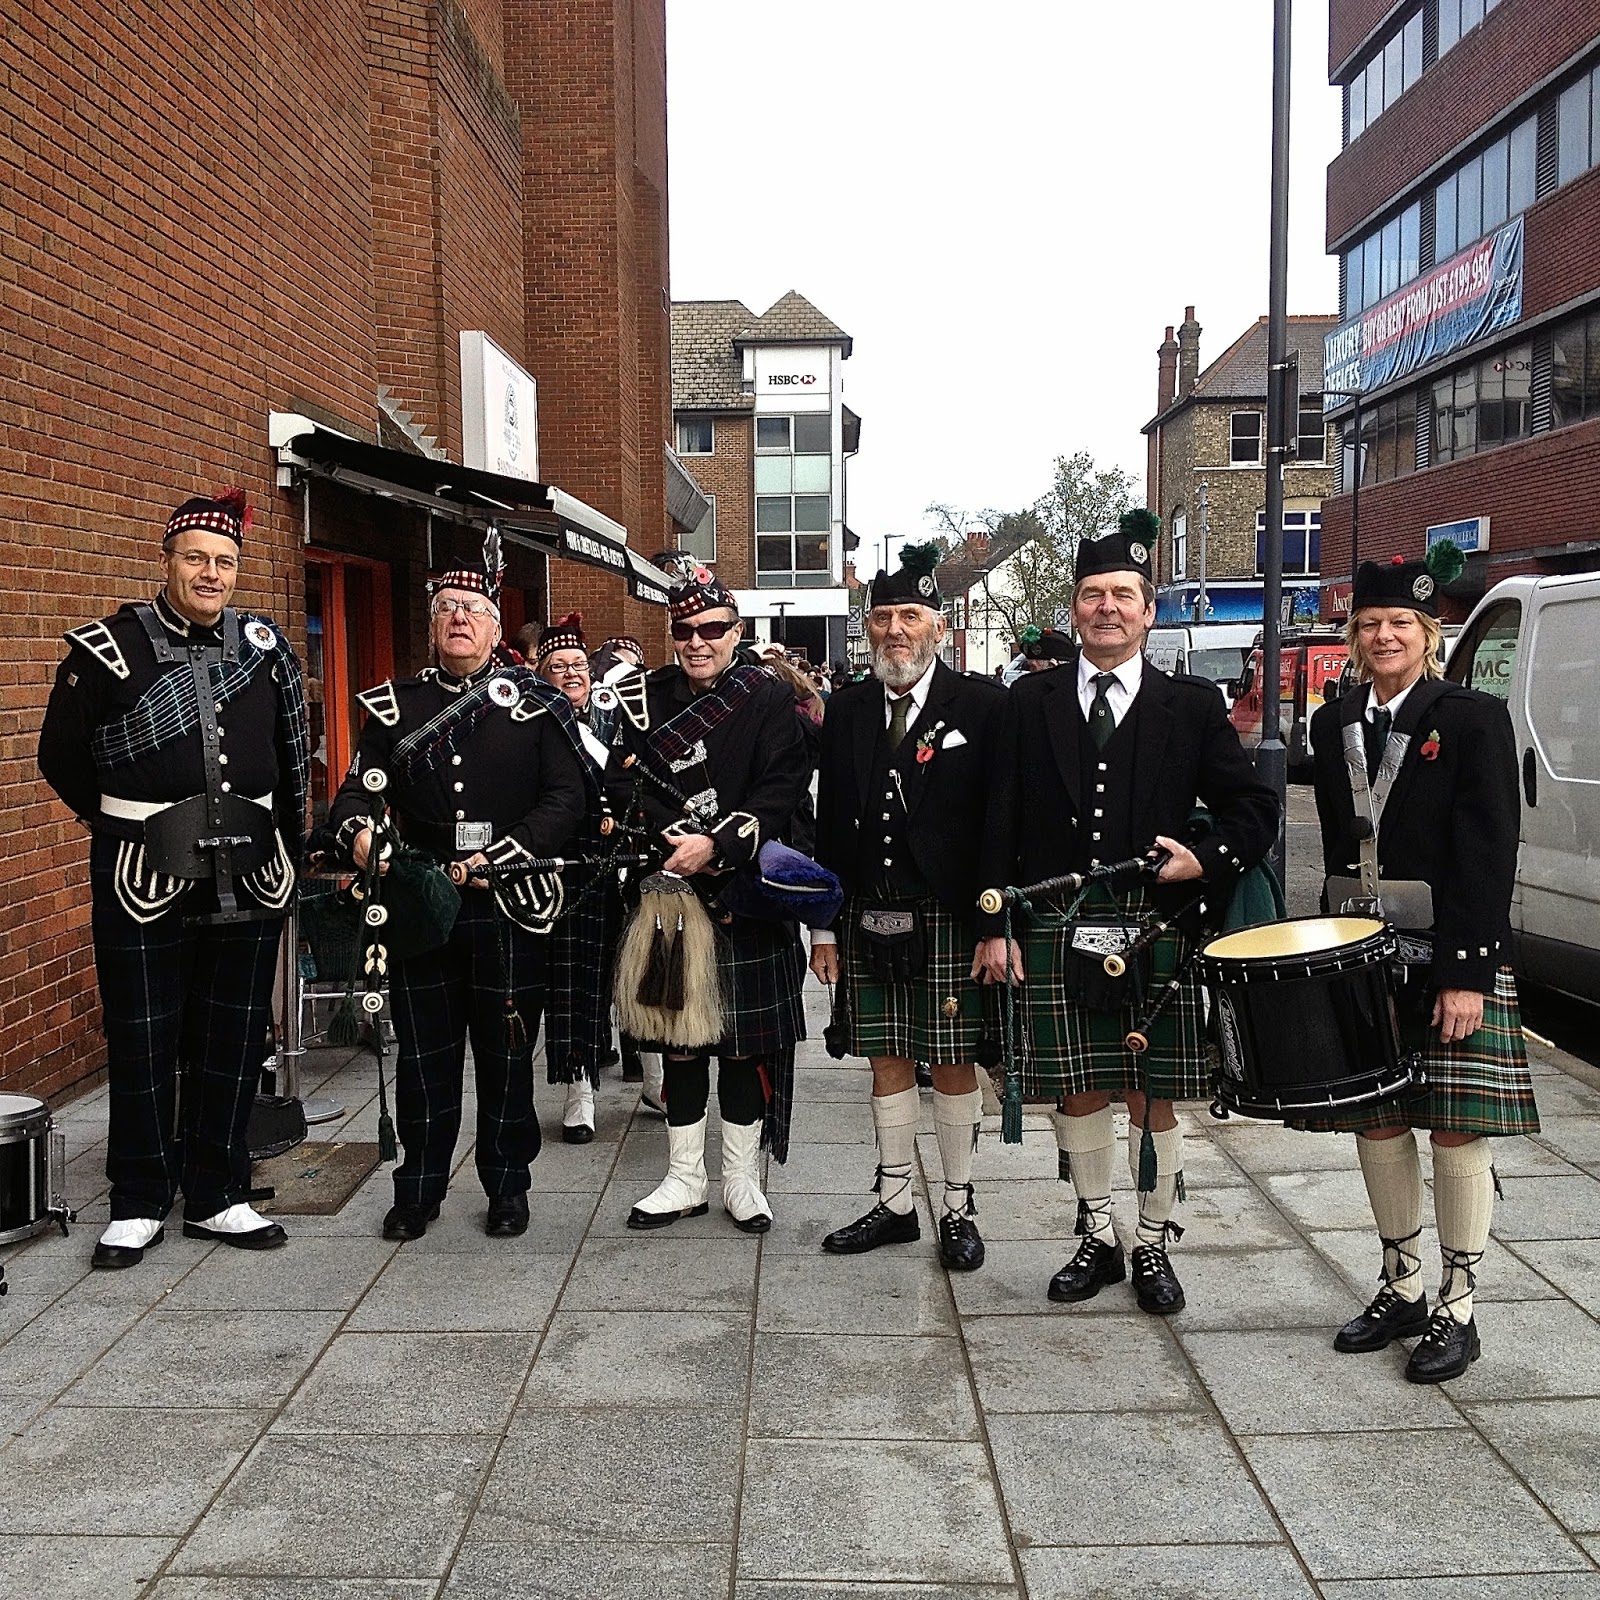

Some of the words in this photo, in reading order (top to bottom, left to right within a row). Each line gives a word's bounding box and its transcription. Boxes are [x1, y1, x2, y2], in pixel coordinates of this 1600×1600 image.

[1363, 315, 1377, 352] BUY
[1377, 310, 1387, 344] OR
[1388, 297, 1406, 338] RENT
[1406, 284, 1428, 327] FROM
[1428, 273, 1448, 315] JUST
[1449, 250, 1489, 304] £199,950
[1325, 322, 1360, 370] LUXURY
[768, 375, 799, 385] HSBC
[1221, 1005, 1243, 1082] ANDANTE
